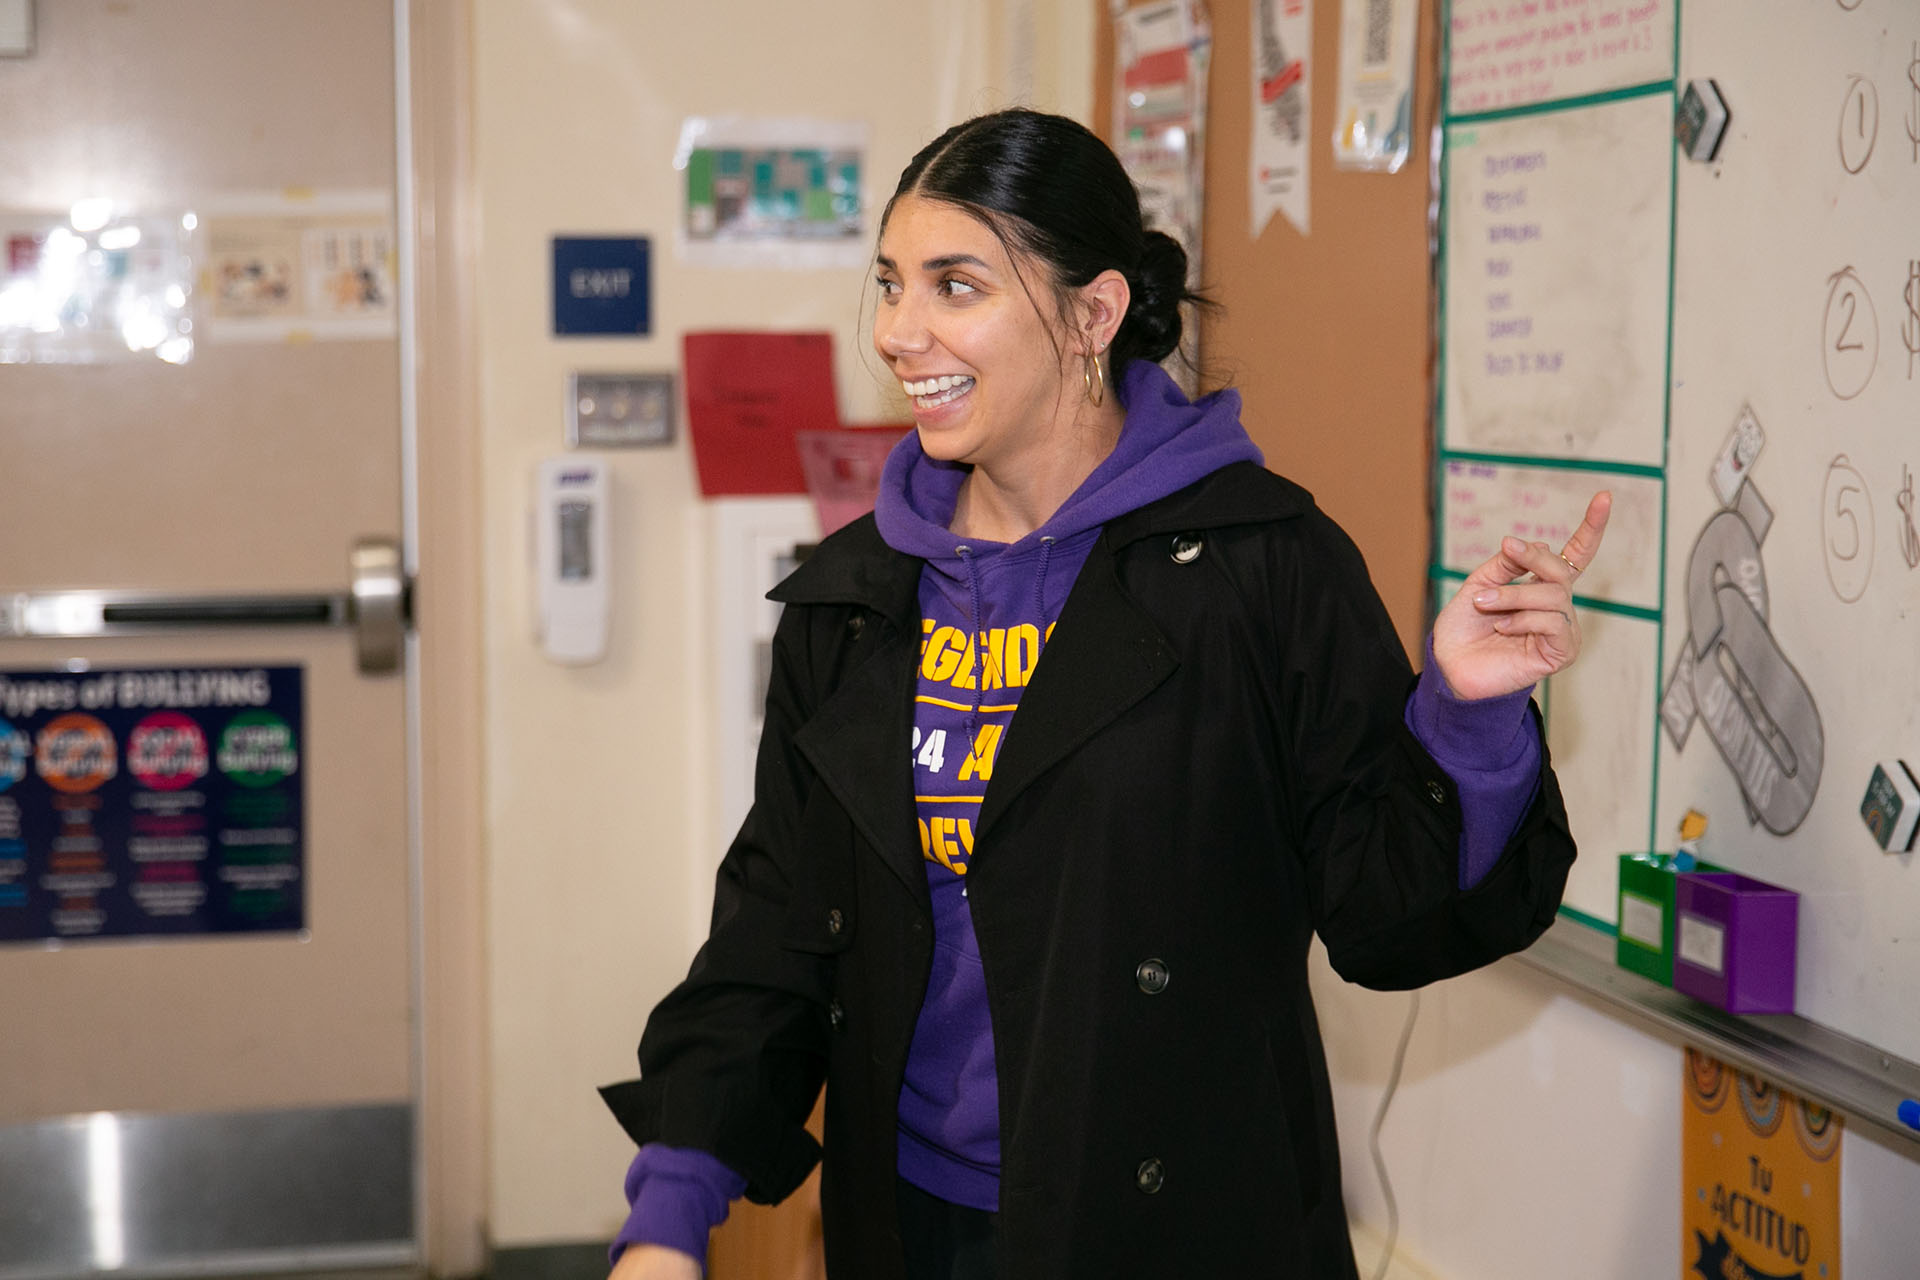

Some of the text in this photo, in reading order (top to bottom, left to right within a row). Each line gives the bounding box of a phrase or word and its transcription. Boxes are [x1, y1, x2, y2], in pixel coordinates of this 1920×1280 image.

[569, 267, 632, 298] EXIT
[917, 618, 1057, 692] GEND
[80, 672, 117, 709] of
[118, 668, 271, 707] BULLYING
[1710, 1183, 1811, 1267] ACTITUD
